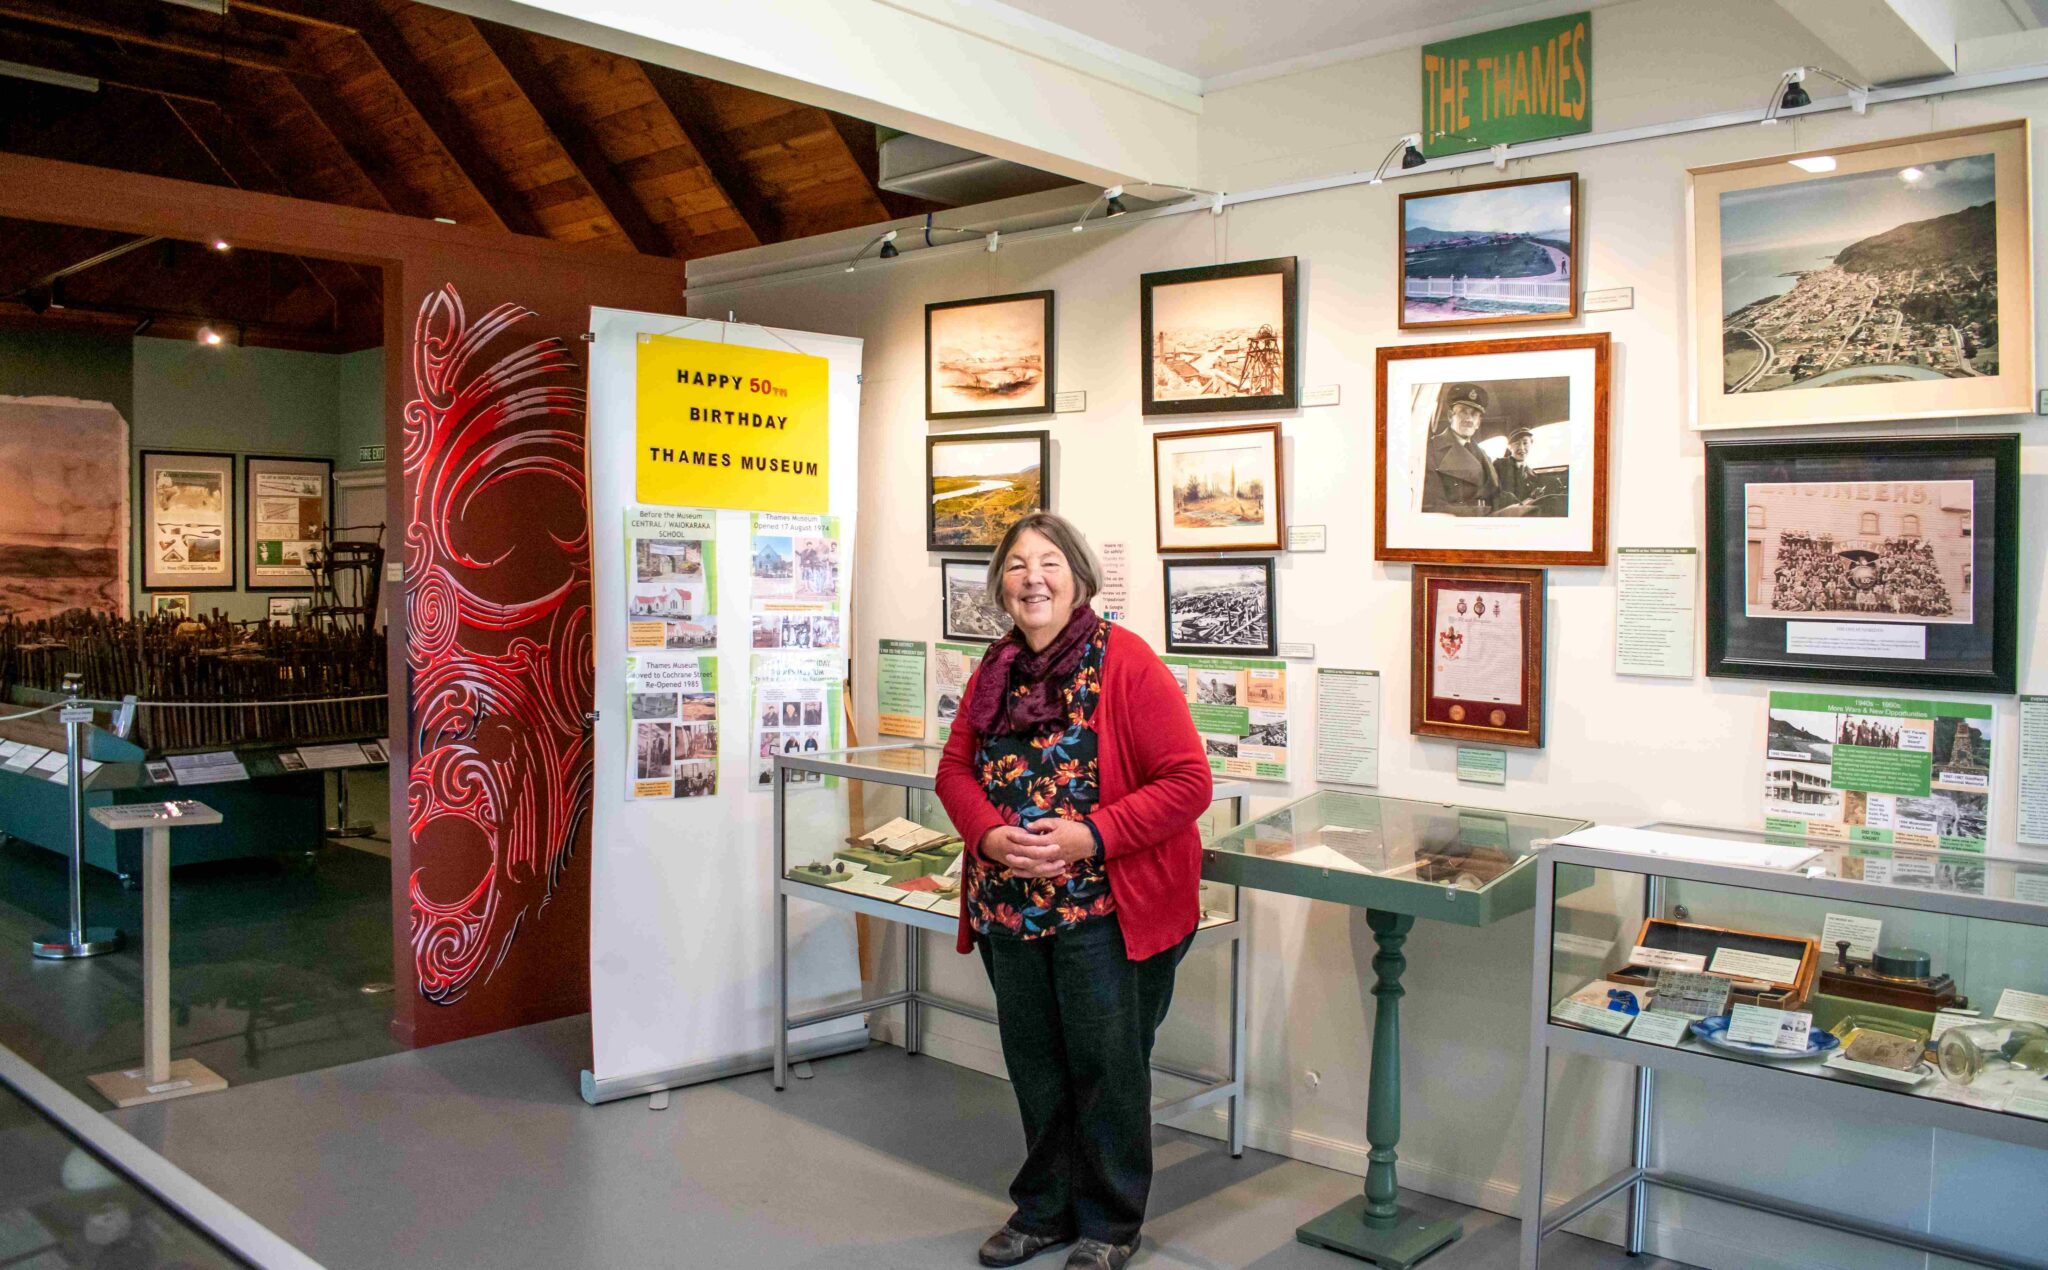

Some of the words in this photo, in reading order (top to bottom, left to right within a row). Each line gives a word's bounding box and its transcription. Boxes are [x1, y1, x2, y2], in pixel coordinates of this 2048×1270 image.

[1424, 54, 1470, 145] THE
[1476, 22, 1586, 121] THAMES
[677, 369, 742, 390] HAPPY
[690, 407, 787, 430] BIRTHDAY
[650, 447, 731, 467] THAMES
[741, 456, 818, 476] MUSEUM
[639, 510, 663, 518] Before
[765, 513, 791, 521] Thames
[631, 520, 662, 528] CENTRAL
[753, 521, 779, 530] Opened
[790, 524, 812, 532] August
[658, 530, 685, 538] SCHOOL
[646, 661, 671, 669] Thames
[662, 671, 692, 679] Cochrane
[645, 681, 682, 689] Re-Opened
[1855, 699, 1874, 707] 1940s
[1827, 704, 1844, 712] More
[1844, 705, 1862, 713] Wars
[1869, 707, 1884, 715] New
[1884, 709, 1928, 718] Opportunities
